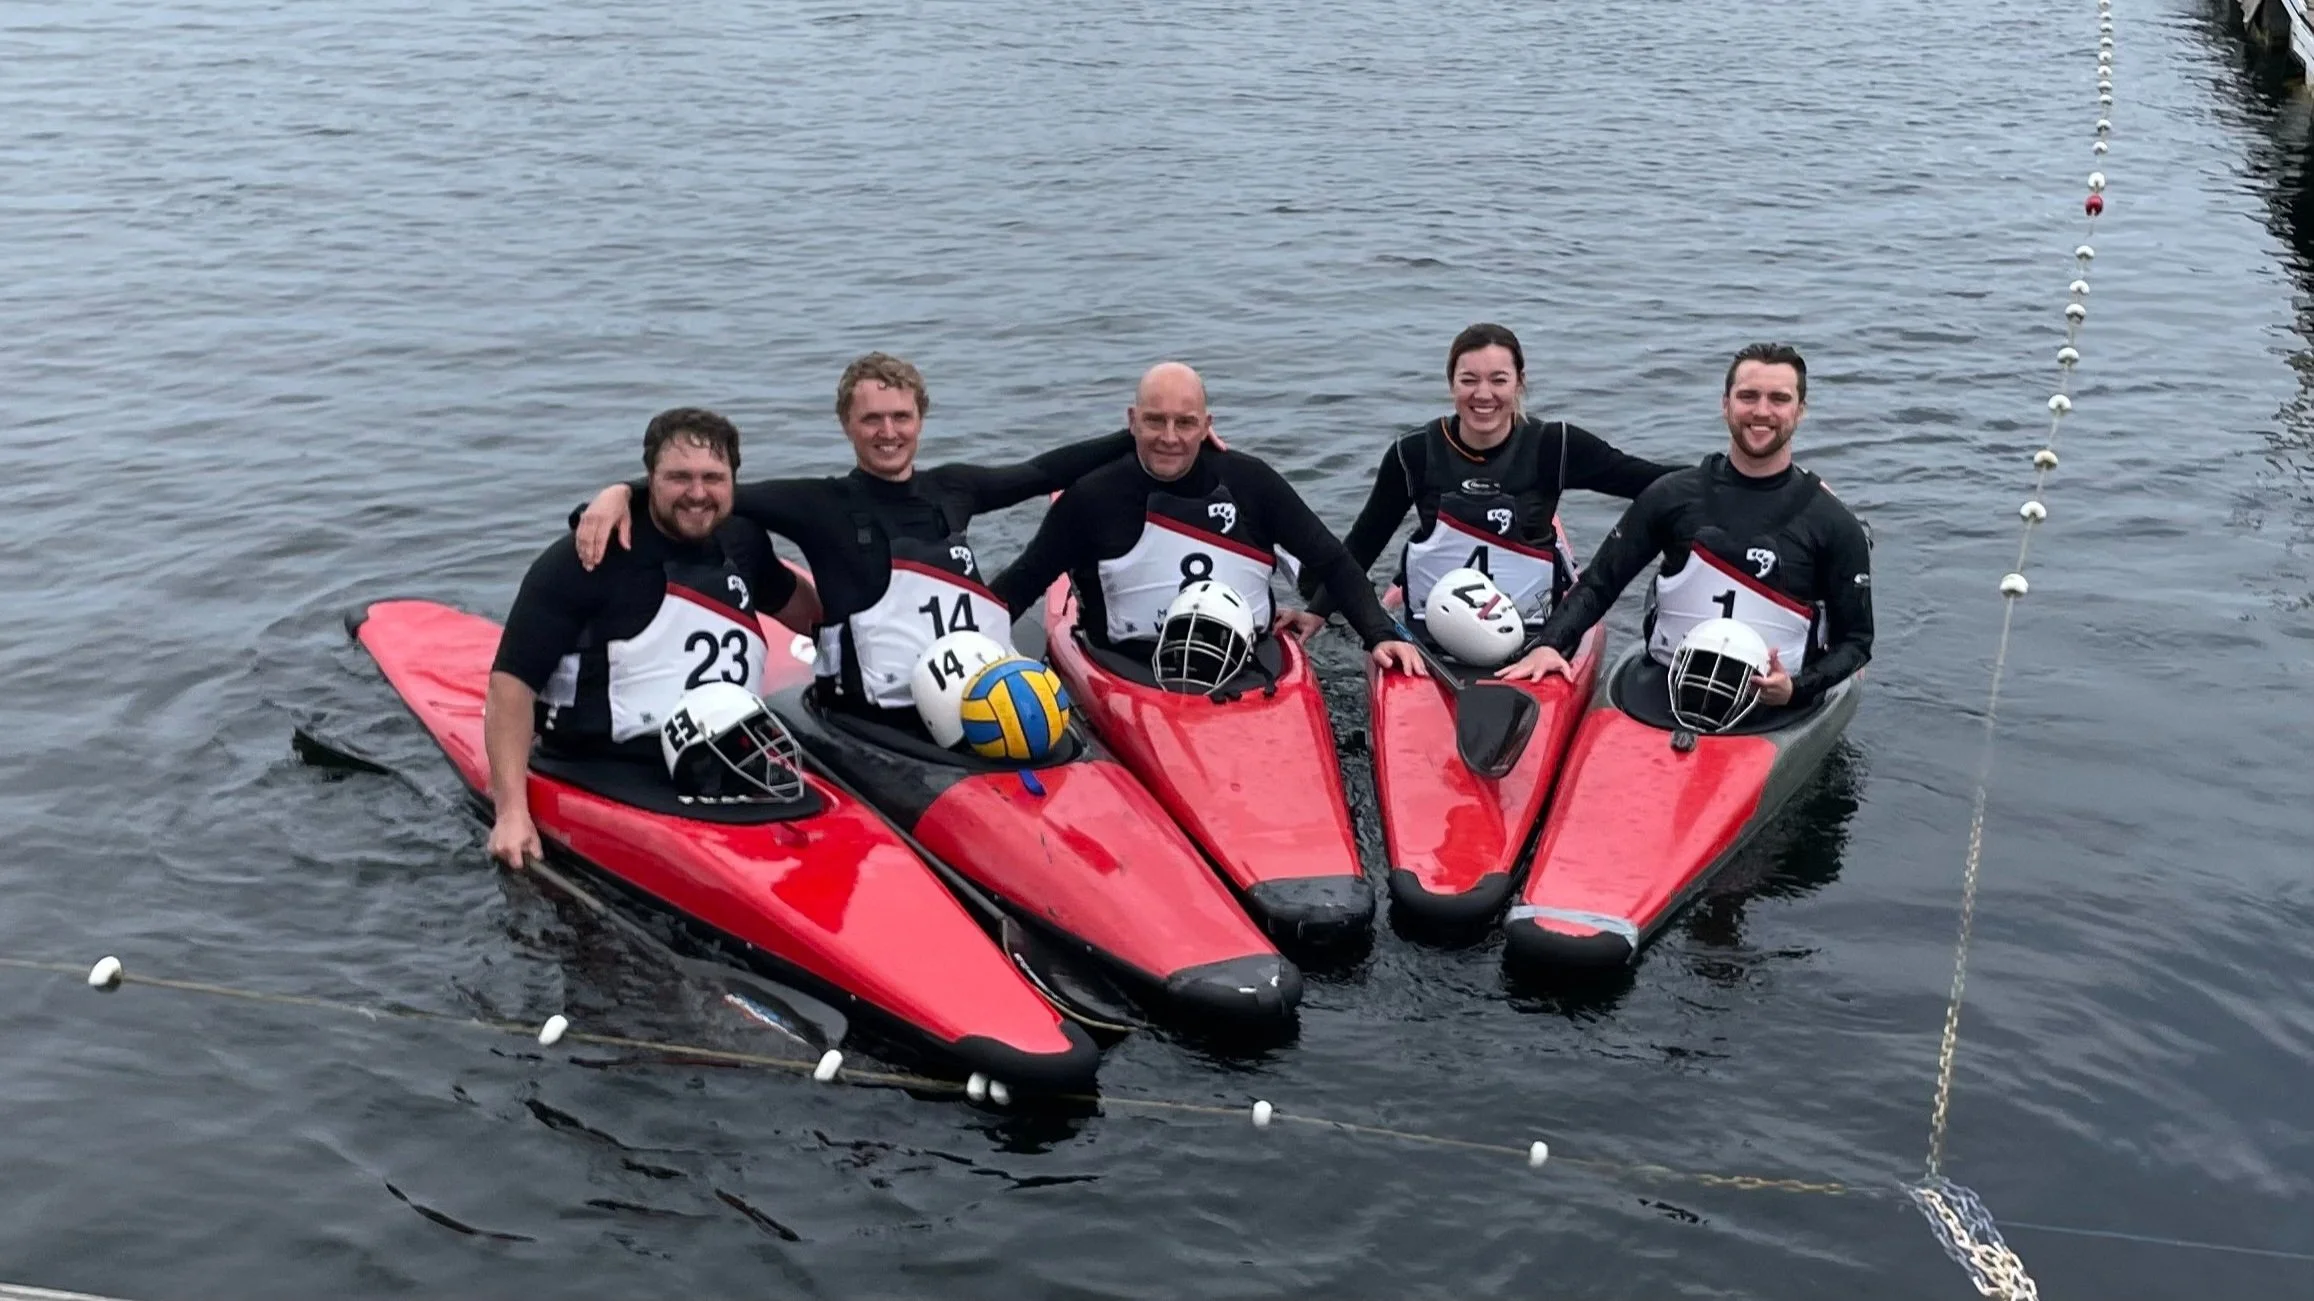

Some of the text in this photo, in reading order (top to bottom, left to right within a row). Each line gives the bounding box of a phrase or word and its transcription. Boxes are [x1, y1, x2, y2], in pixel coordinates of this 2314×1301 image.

[918, 593, 980, 640] 14
[684, 629, 750, 691] 23
[927, 648, 965, 692] 14
[664, 707, 699, 753] 23
